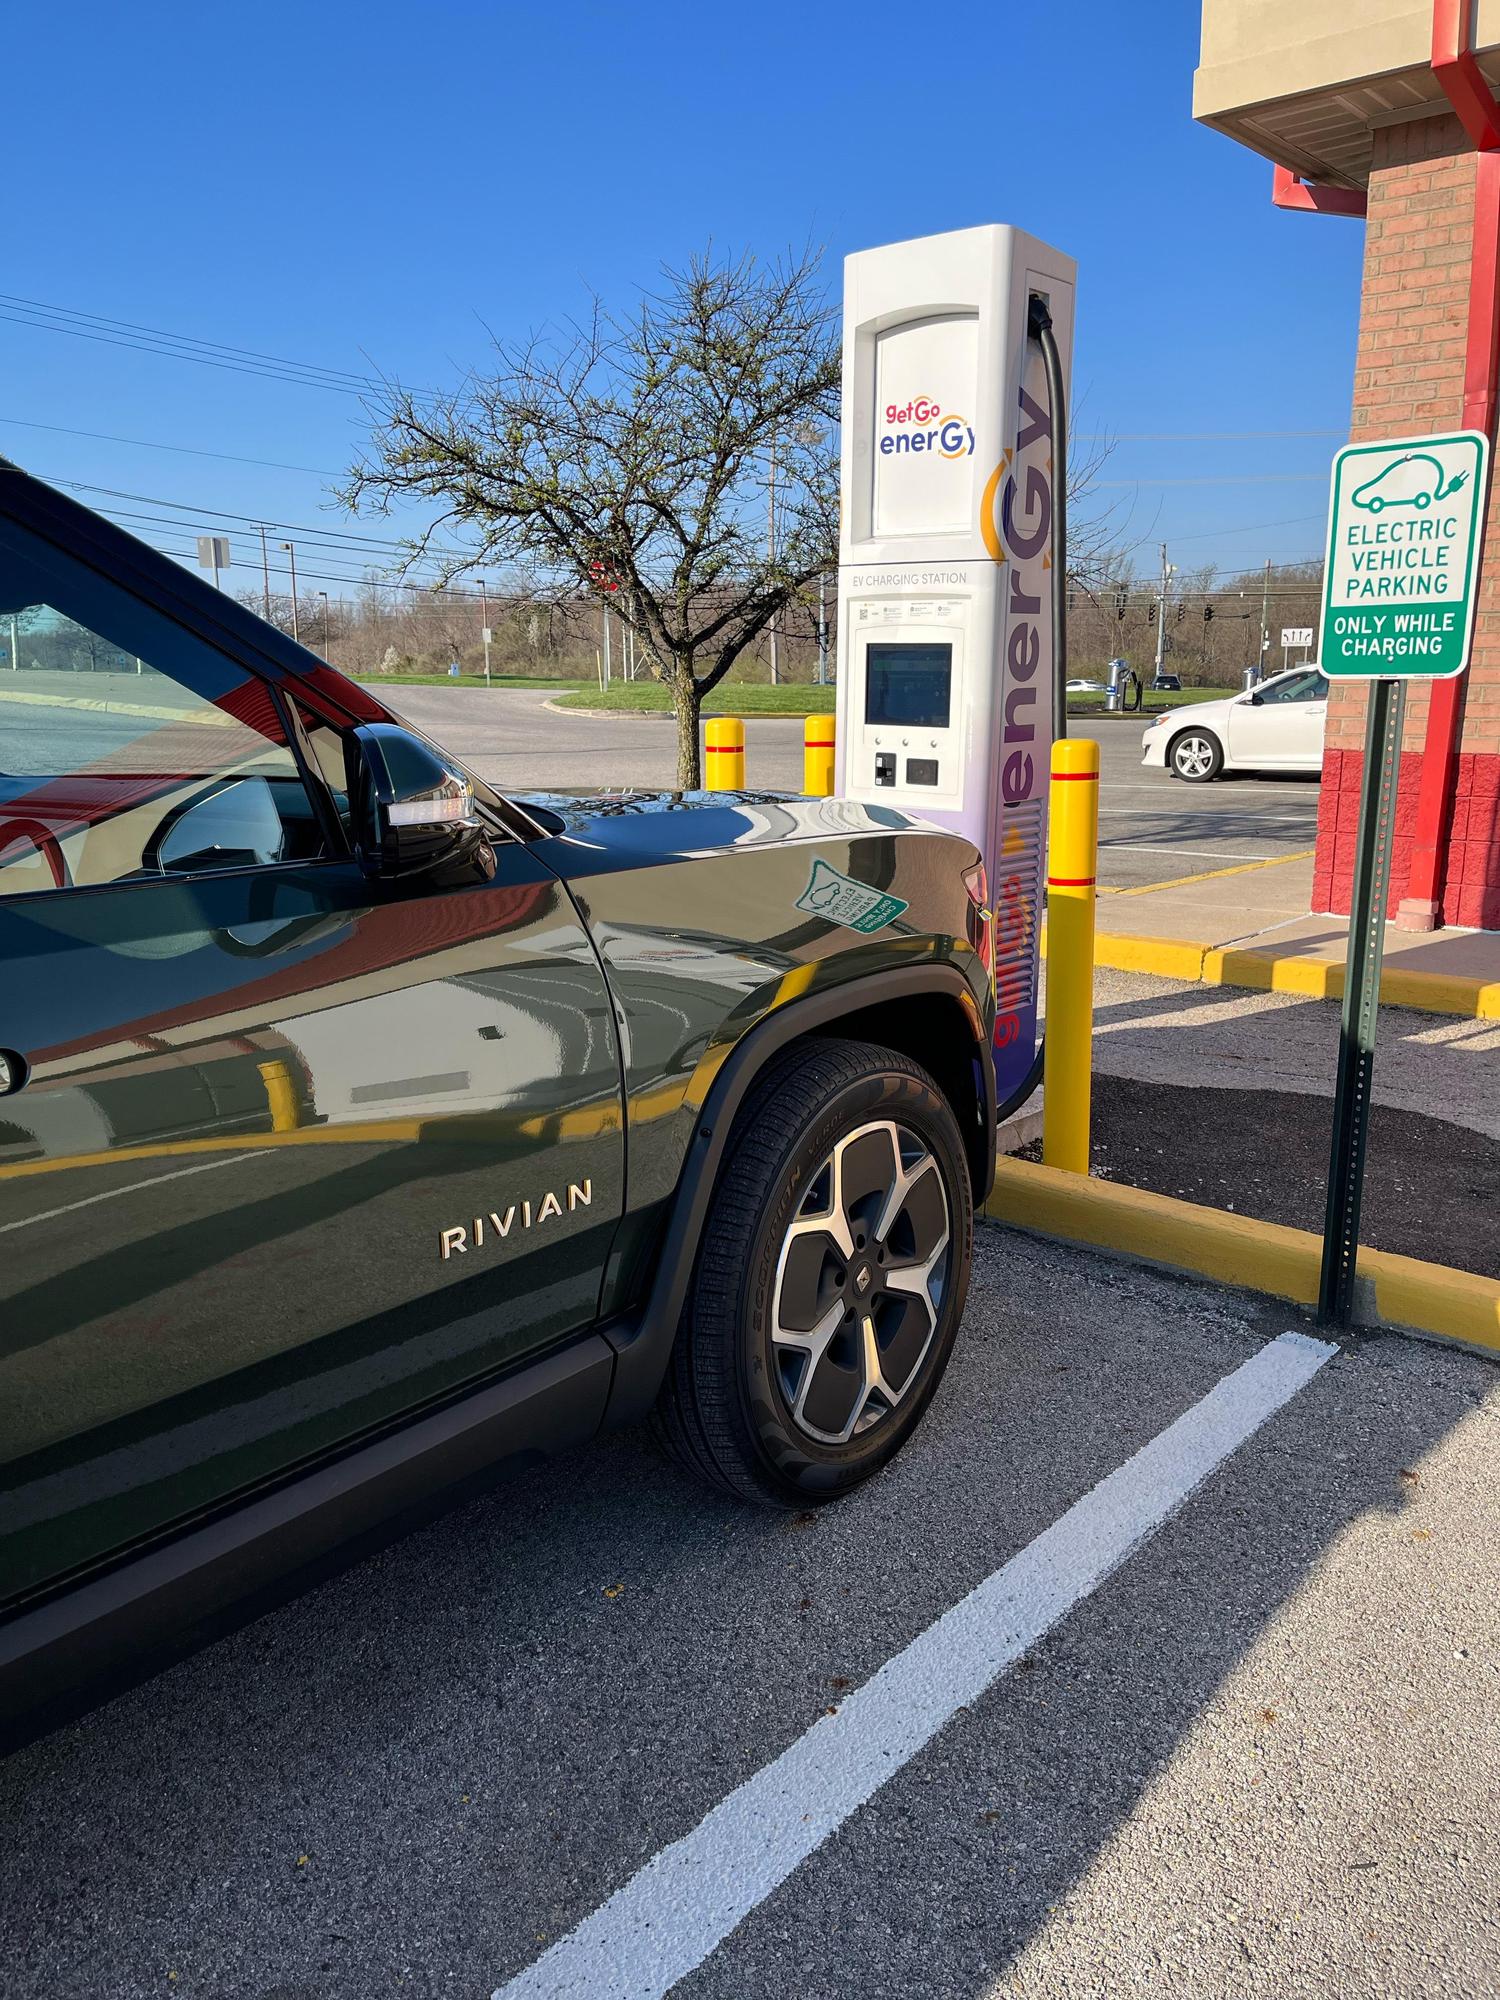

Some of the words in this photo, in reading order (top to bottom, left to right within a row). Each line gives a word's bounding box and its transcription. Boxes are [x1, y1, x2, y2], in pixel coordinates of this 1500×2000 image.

[886, 400, 940, 424] getGo
[880, 421, 976, 456] enerGy
[1347, 517, 1458, 546] ELECTRIC
[1351, 545, 1450, 572] VEHICLE
[852, 575, 865, 587] EV
[865, 573, 919, 587] CHARGING
[921, 572, 967, 585] STATION
[1346, 573, 1448, 599] PARKING
[1001, 386, 1052, 808] enerGy
[1334, 614, 1387, 635] ONLY
[1393, 612, 1456, 633] WHILE
[1341, 636, 1443, 657] CHARGING
[440, 1178, 592, 1260] RIVIAN
